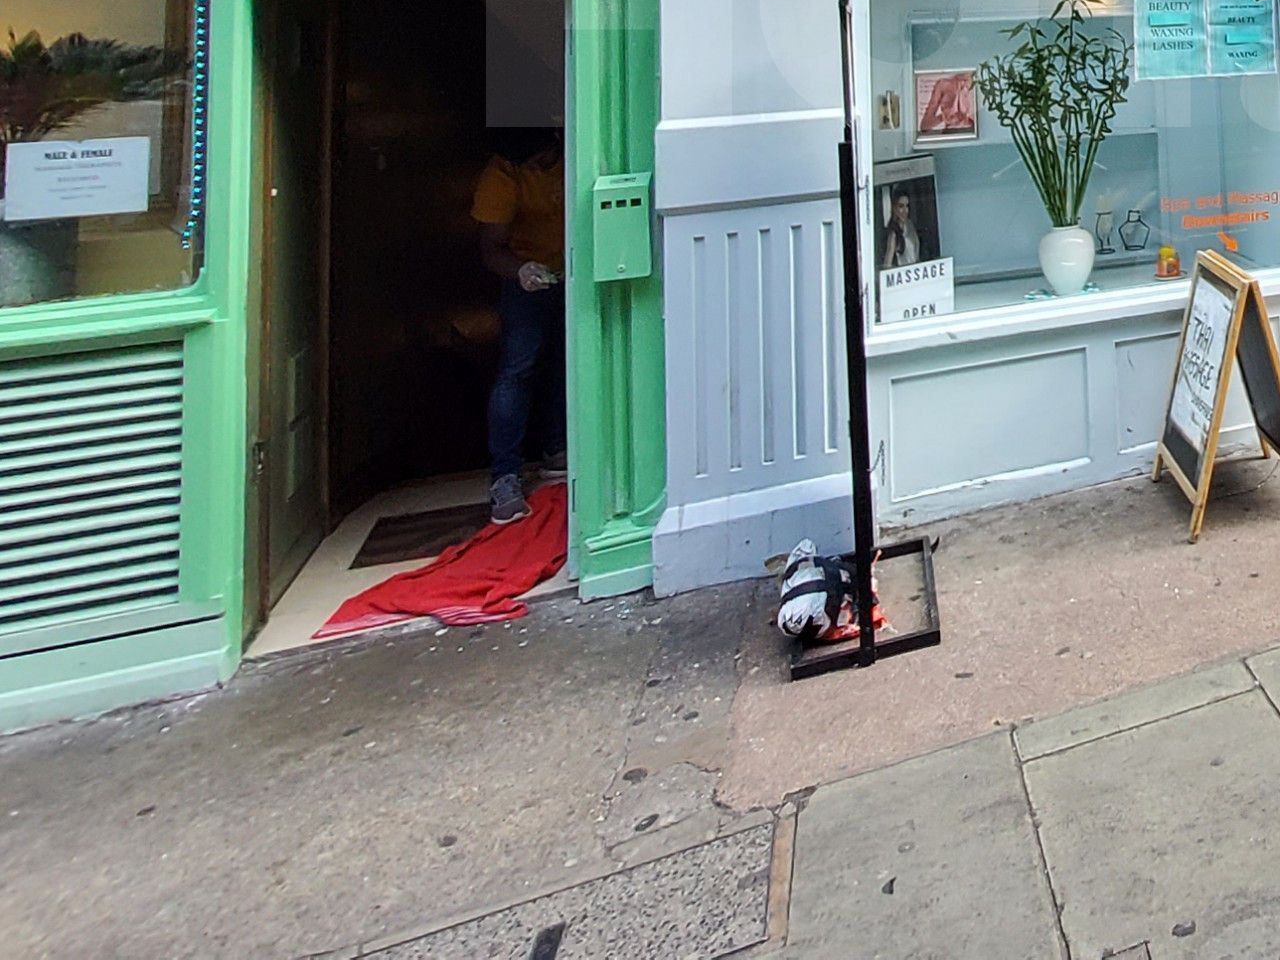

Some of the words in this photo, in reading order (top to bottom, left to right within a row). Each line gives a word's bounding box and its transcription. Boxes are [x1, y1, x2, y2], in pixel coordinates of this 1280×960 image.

[1148, 1, 1192, 12] BEAUTY
[1150, 28, 1194, 39] WAXING
[1152, 41, 1194, 52] LASHES
[885, 262, 946, 289] MASSAGE
[903, 304, 937, 319] OPEN
